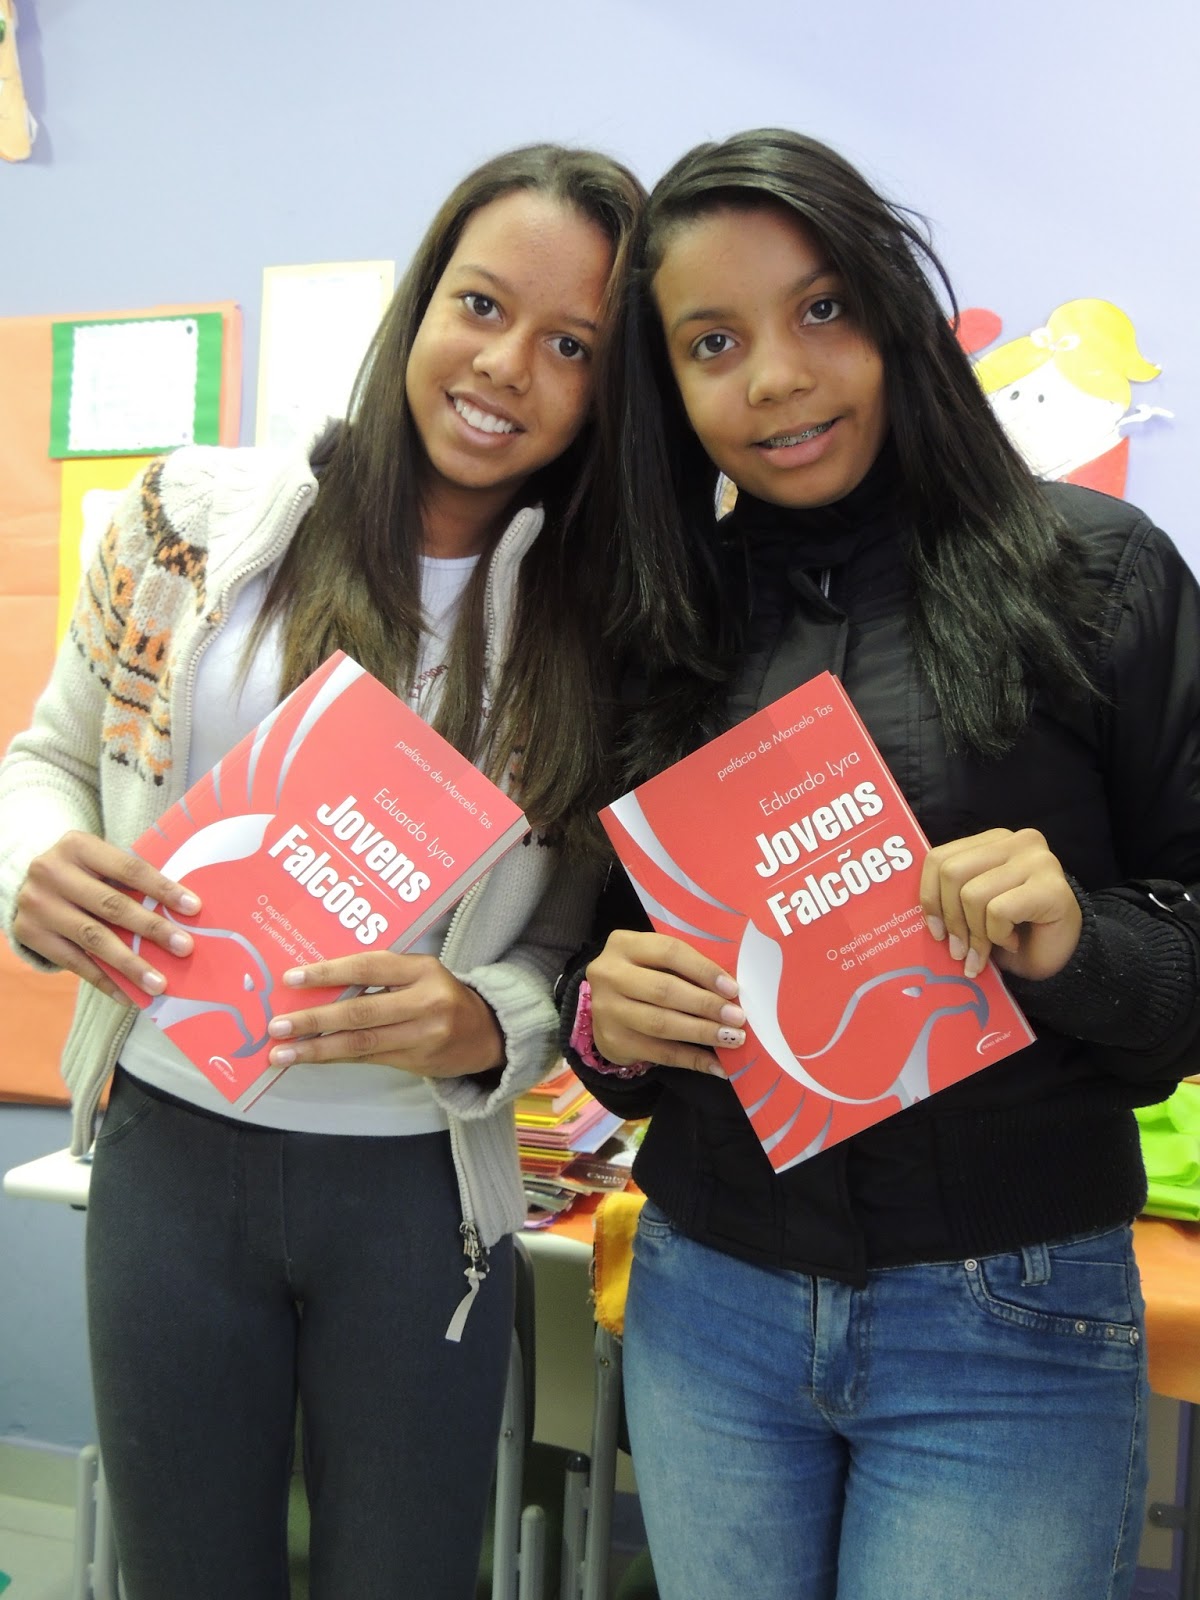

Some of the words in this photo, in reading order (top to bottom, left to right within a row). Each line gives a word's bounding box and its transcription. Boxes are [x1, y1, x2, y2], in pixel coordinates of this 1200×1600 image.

[717, 751, 757, 781] prefácio
[758, 740, 772, 754] de
[772, 715, 815, 745] Marcelo
[814, 704, 833, 719] Tas
[395, 741, 431, 772] prefácio
[430, 771, 443, 783] de
[442, 780, 478, 815] Marcelo
[478, 811, 493, 829] Tas
[759, 771, 825, 816] Eduardo
[826, 751, 861, 777] Lyra
[316, 795, 431, 903] Jovens
[373, 788, 427, 841] Eduardo
[427, 837, 456, 868] Lyra
[754, 781, 884, 878] Jovens
[257, 894, 269, 906] O
[265, 905, 292, 931] espírito
[268, 824, 389, 945] Falcões
[766, 834, 914, 937] Falcões
[251, 911, 264, 924] da
[261, 920, 296, 956] juventude
[826, 949, 838, 960] O
[840, 932, 873, 953] espírito
[873, 904, 924, 936] transforma
[841, 958, 856, 971] da
[856, 934, 900, 966] juventude
[899, 915, 928, 938] brasil
